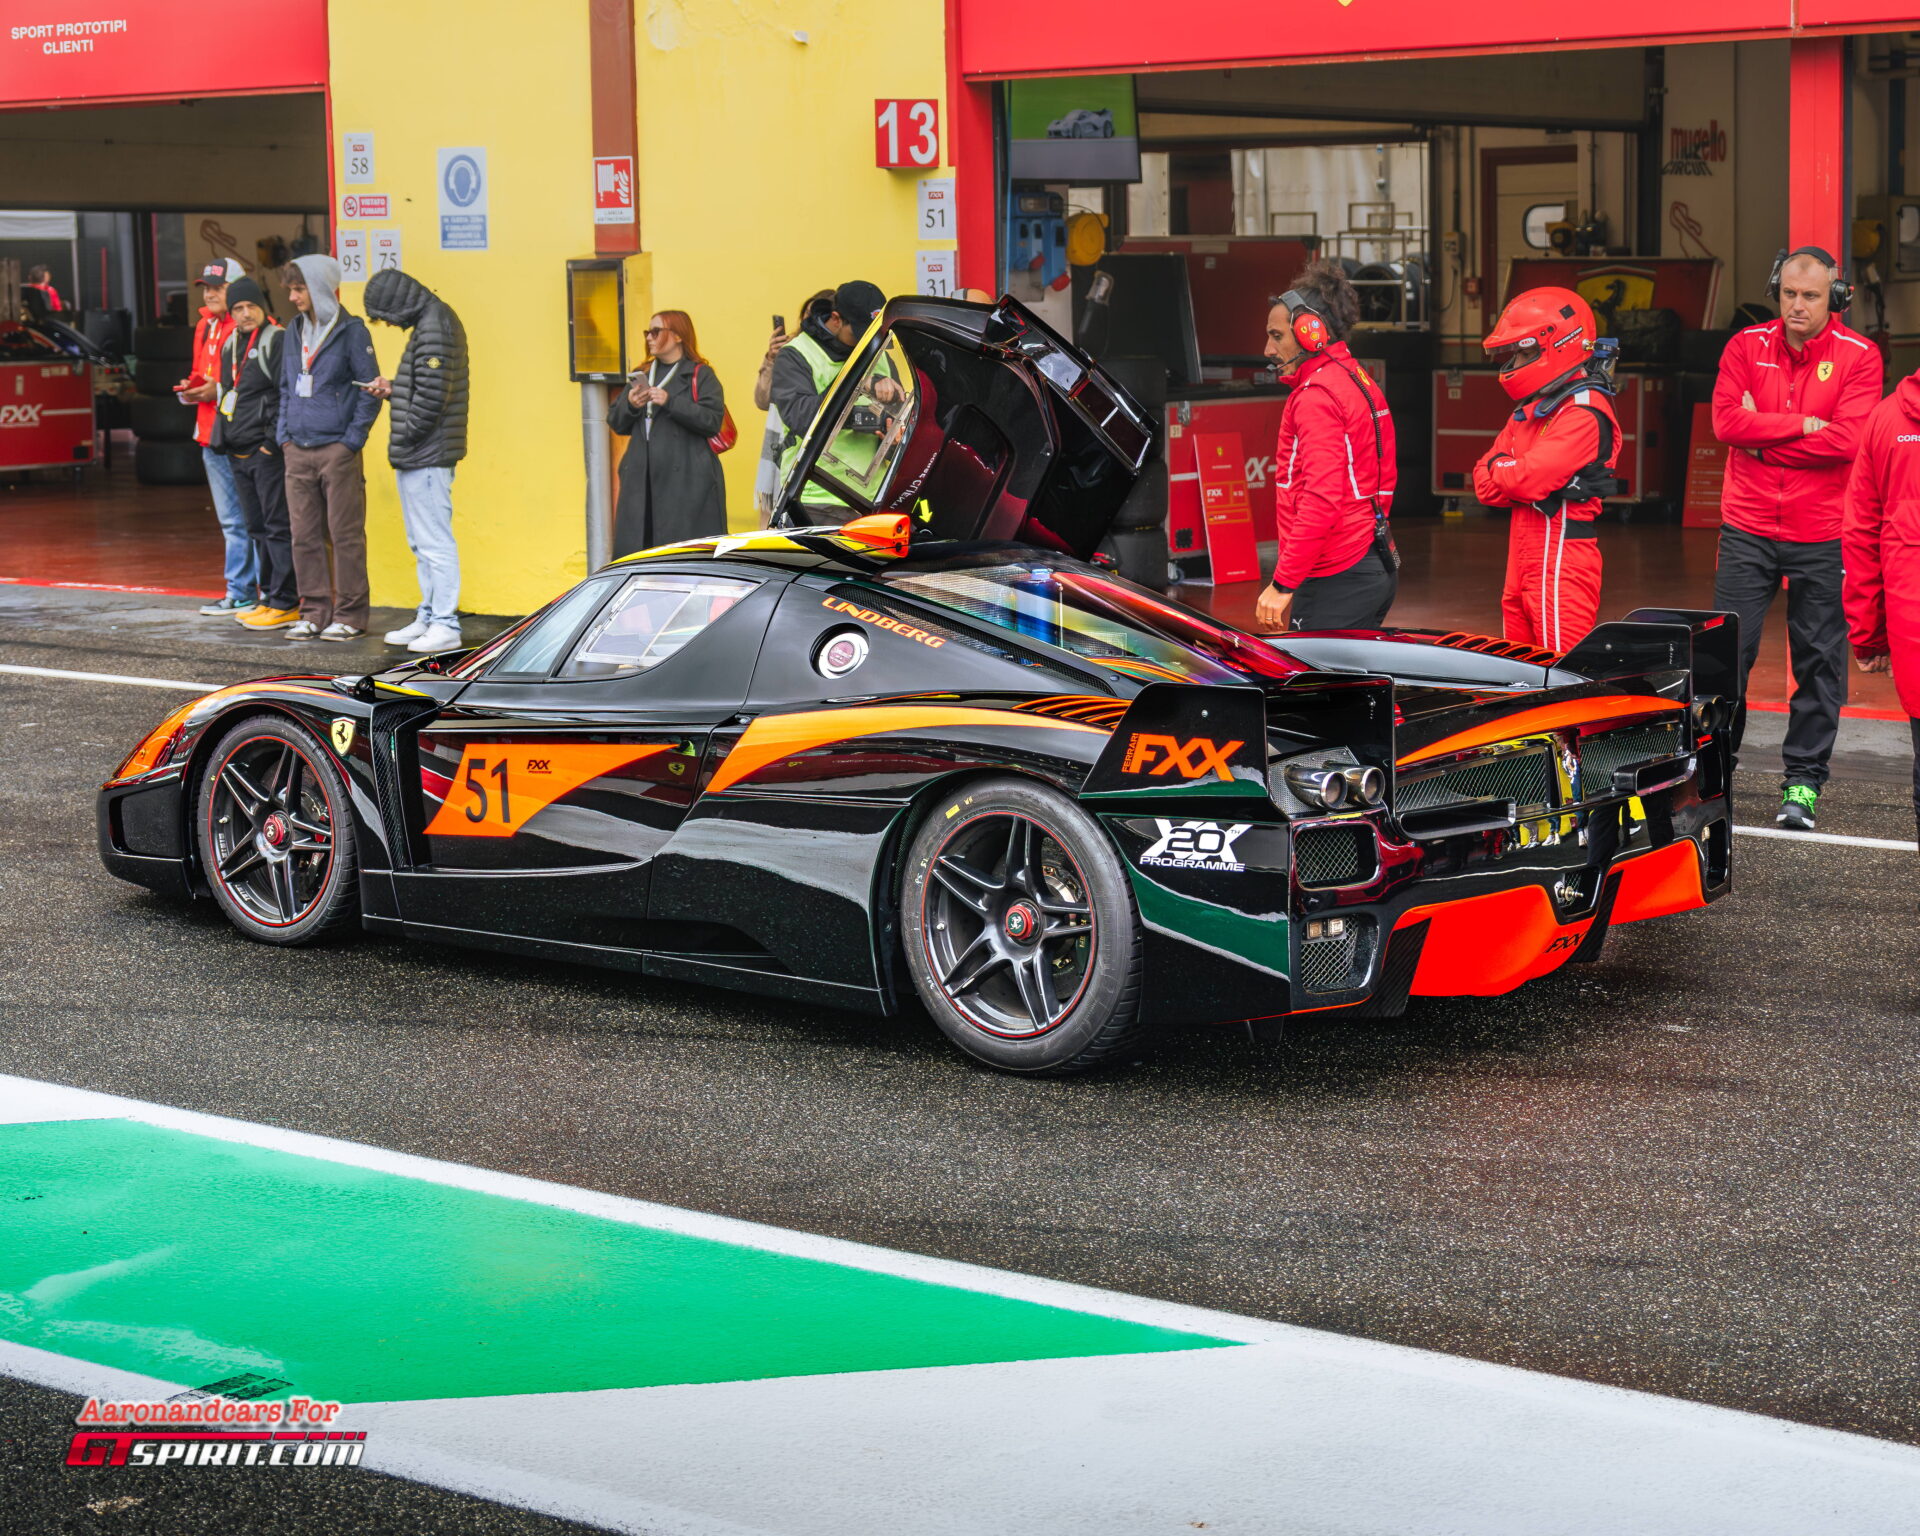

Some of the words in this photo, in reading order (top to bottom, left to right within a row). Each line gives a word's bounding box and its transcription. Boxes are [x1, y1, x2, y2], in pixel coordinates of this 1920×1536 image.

[11, 24, 54, 40] SPORT
[56, 19, 127, 37] PROTOTIPI
[43, 39, 94, 55] CLIENTI
[878, 101, 937, 165] 13
[350, 157, 369, 175] 58
[925, 208, 945, 228] 51
[343, 254, 361, 273] 95
[379, 252, 397, 270] 75
[926, 278, 946, 297] 31
[0, 403, 43, 423] FXX
[1206, 489, 1222, 497] FXX
[821, 596, 947, 649] LINDBERG
[1121, 733, 1140, 772] FERRARI
[1129, 733, 1245, 782] FXX
[527, 759, 551, 770] FXX
[465, 758, 511, 823] 51
[1166, 828, 1226, 854] 20
[1139, 857, 1246, 872] PROGRAMME
